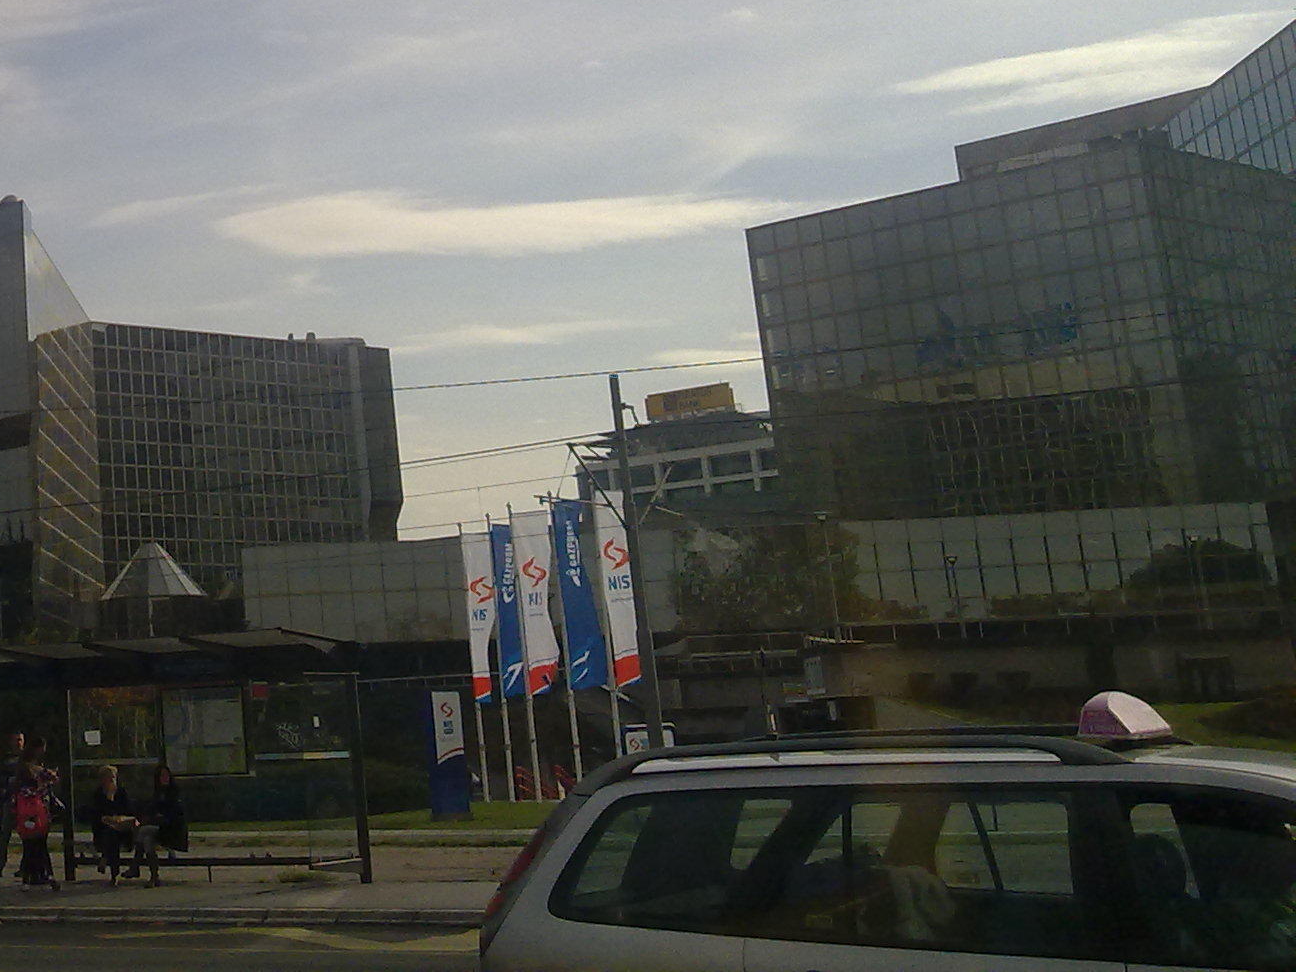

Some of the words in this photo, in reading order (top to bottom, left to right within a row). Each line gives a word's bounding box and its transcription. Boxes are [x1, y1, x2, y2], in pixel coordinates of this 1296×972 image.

[607, 575, 631, 591] NIS
[527, 591, 543, 606] NIS
[471, 609, 488, 621] NIS
